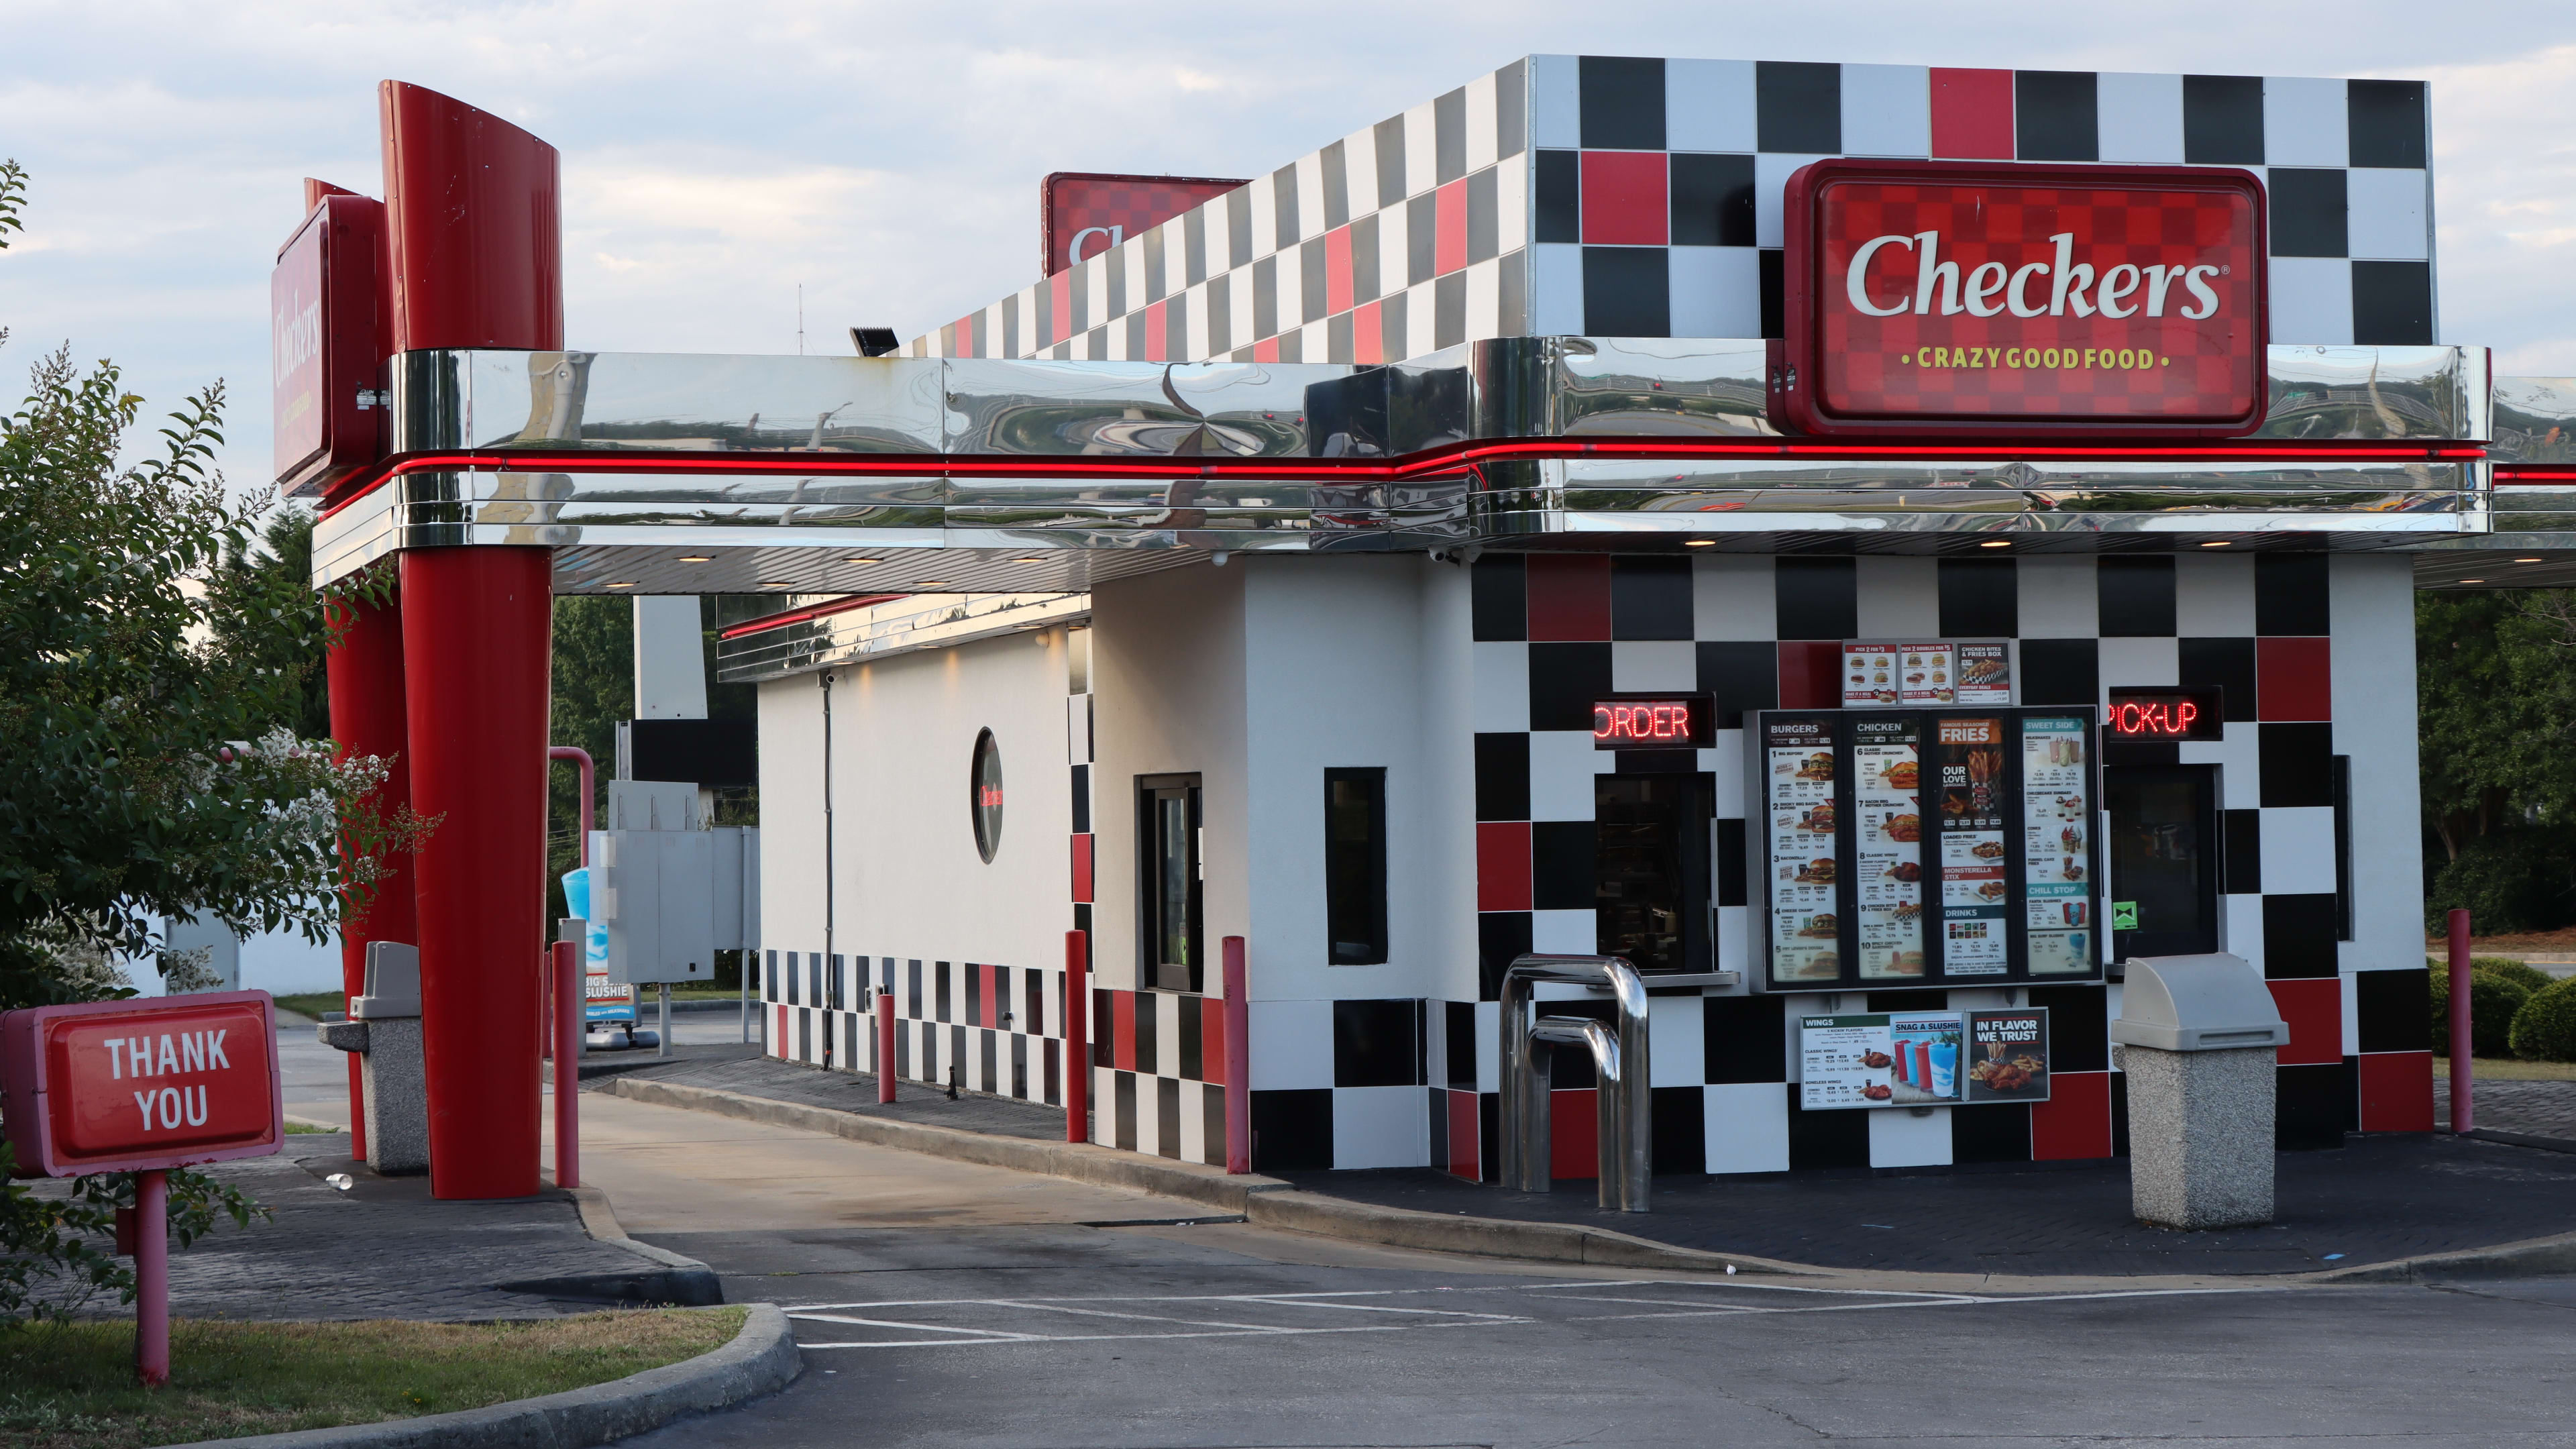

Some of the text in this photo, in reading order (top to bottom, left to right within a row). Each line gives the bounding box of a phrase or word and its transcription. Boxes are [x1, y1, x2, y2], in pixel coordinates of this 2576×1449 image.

[1847, 230, 2220, 319] Checkers
[275, 288, 317, 388] Checkers
[1594, 706, 1689, 737] ORDER
[1857, 723, 1902, 731] CHICKEN
[1771, 724, 1819, 733] BURGERS
[1941, 728, 1989, 742] FRIES
[1943, 766, 1966, 775] OUR
[586, 977, 599, 987] BIG
[586, 986, 628, 998] SLUSHIE
[1977, 1020, 2037, 1031] IN FLAVOR
[1977, 1030, 2037, 1042] WE TRUST
[104, 1029, 230, 1079] THANK
[134, 1085, 208, 1131] YOU
